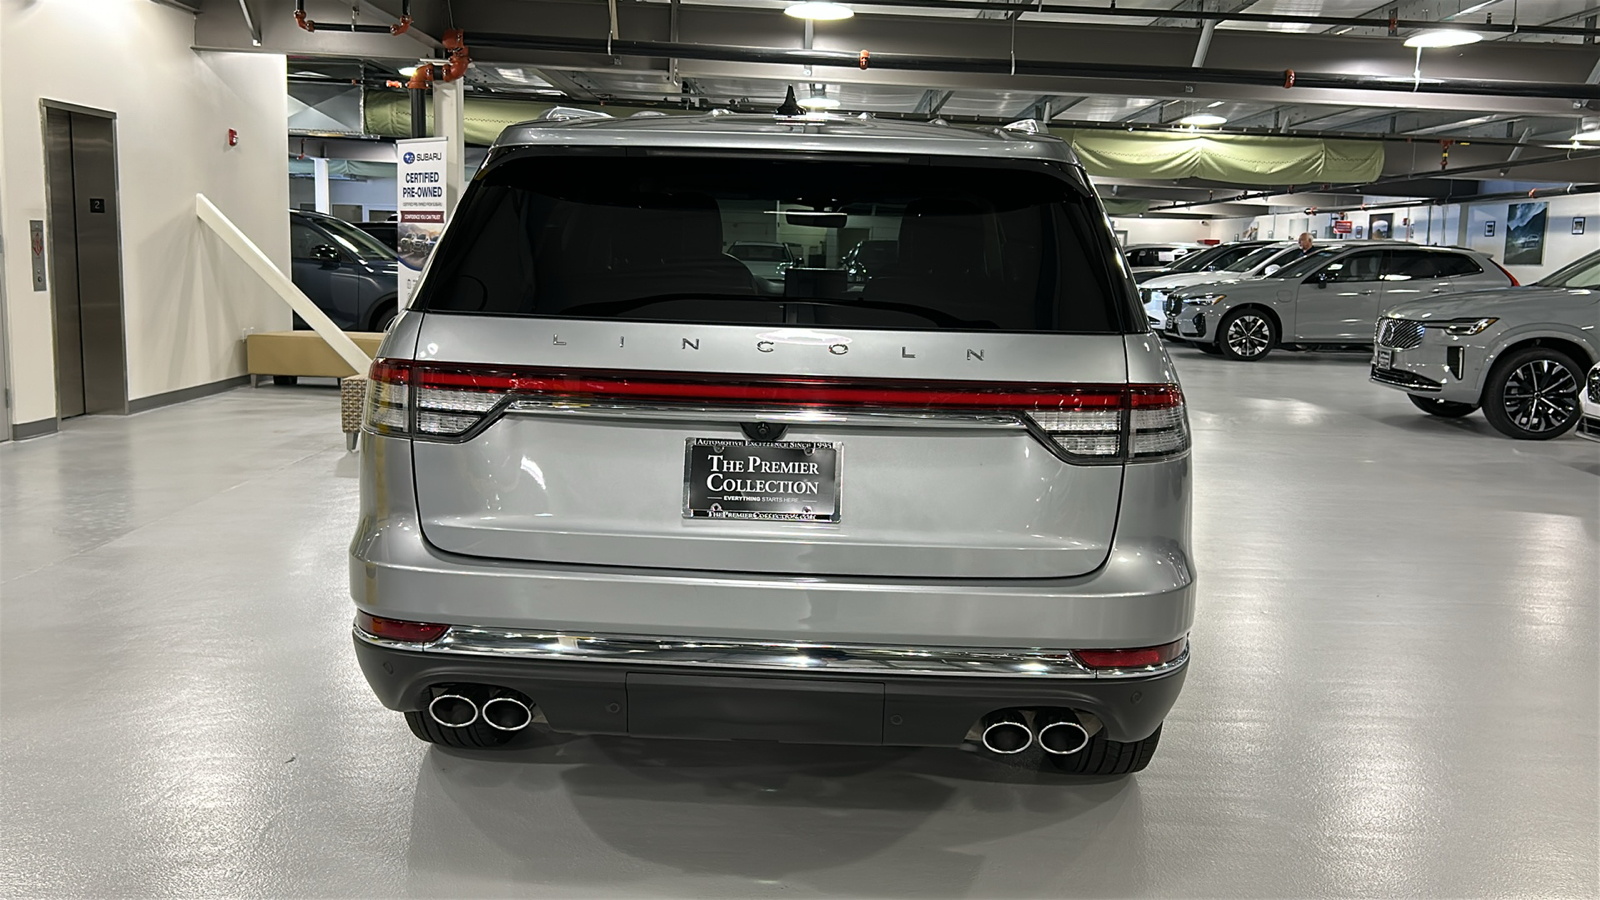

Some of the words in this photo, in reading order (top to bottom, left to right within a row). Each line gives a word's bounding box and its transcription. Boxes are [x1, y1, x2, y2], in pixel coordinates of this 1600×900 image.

[416, 152, 442, 161] SUBARU
[405, 172, 440, 183] CERTIFIED
[402, 187, 443, 198] PRE-OWNED
[94, 200, 100, 209] 2
[552, 333, 985, 362] LINCOLN
[707, 455, 744, 472] THE
[747, 455, 820, 475] PREMIER
[706, 473, 820, 495] COLLECTION
